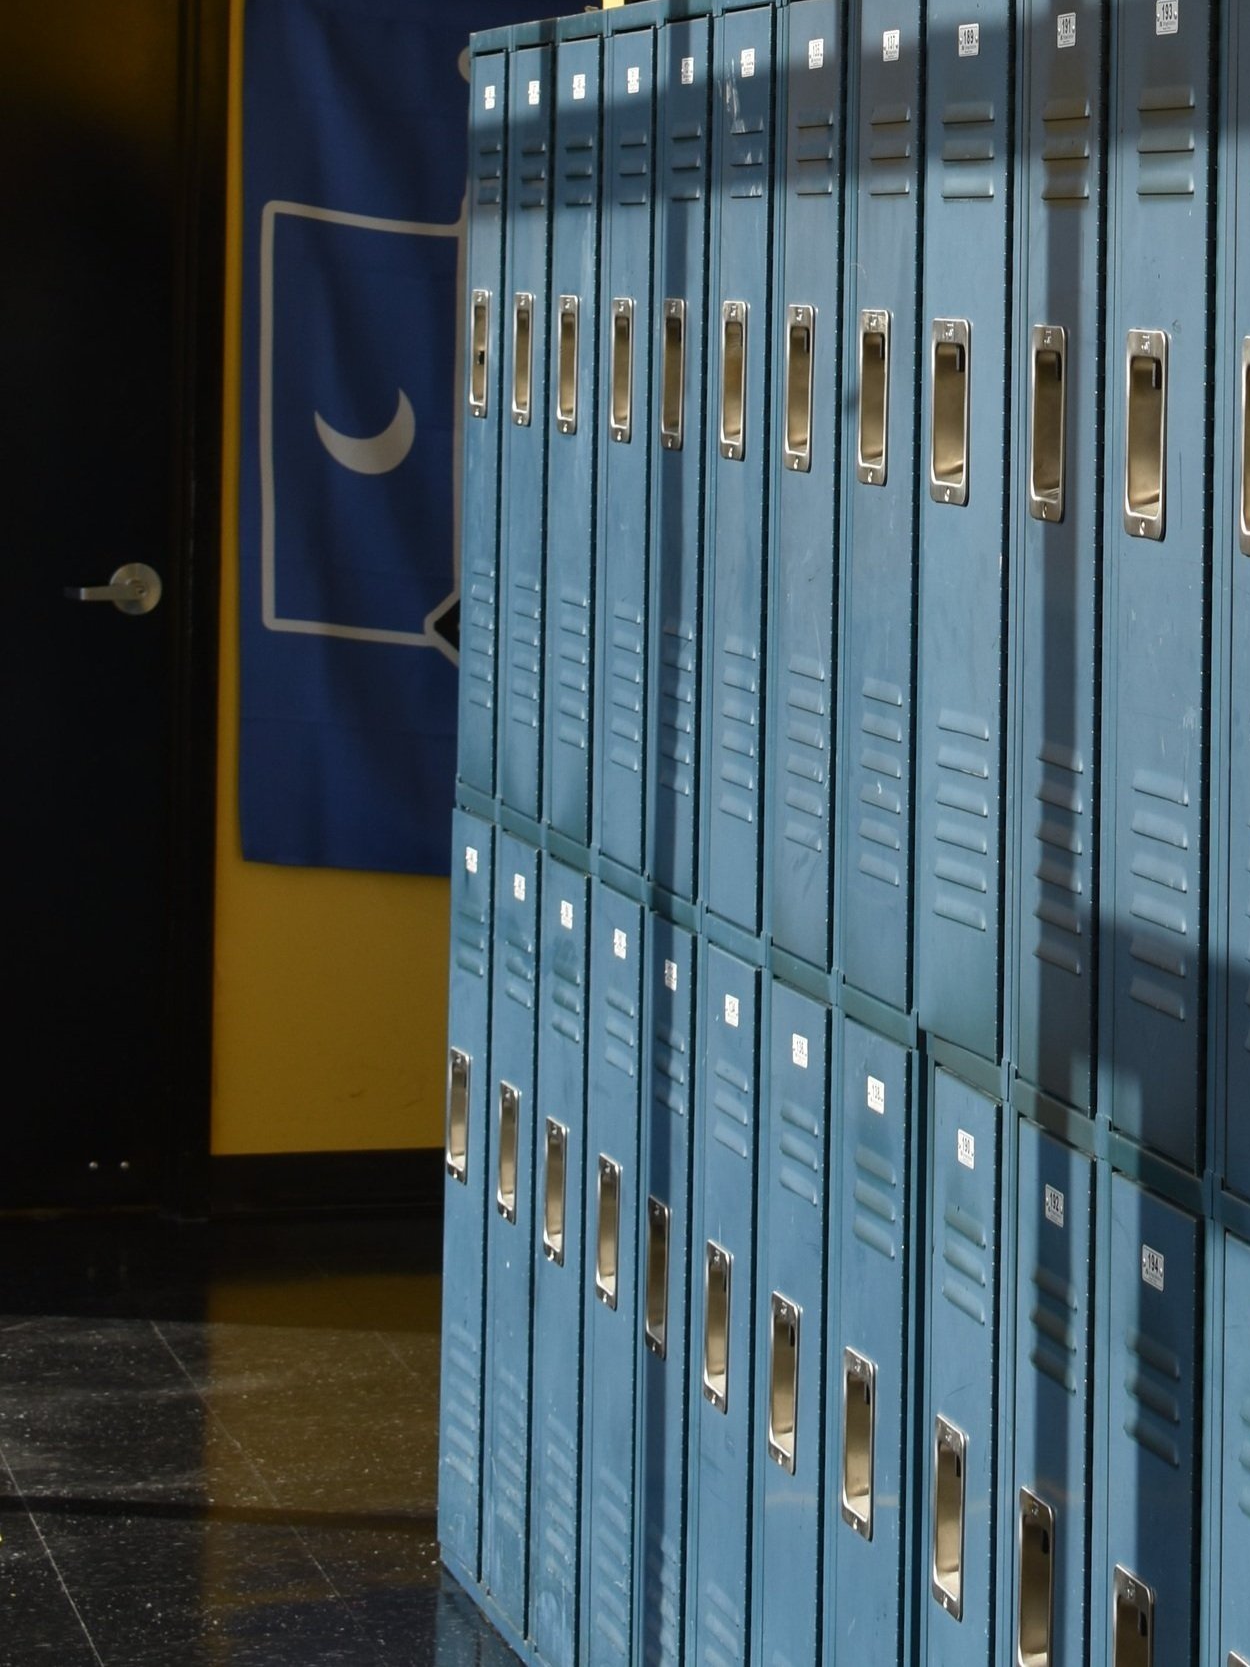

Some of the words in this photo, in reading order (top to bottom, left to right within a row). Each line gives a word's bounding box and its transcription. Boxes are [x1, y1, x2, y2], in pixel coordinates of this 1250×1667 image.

[1162, 3, 1172, 20] 193
[1062, 18, 1071, 35] 191
[963, 29, 974, 44] 189
[1050, 1192, 1059, 1212] 192
[1148, 1253, 1158, 1273] 194
